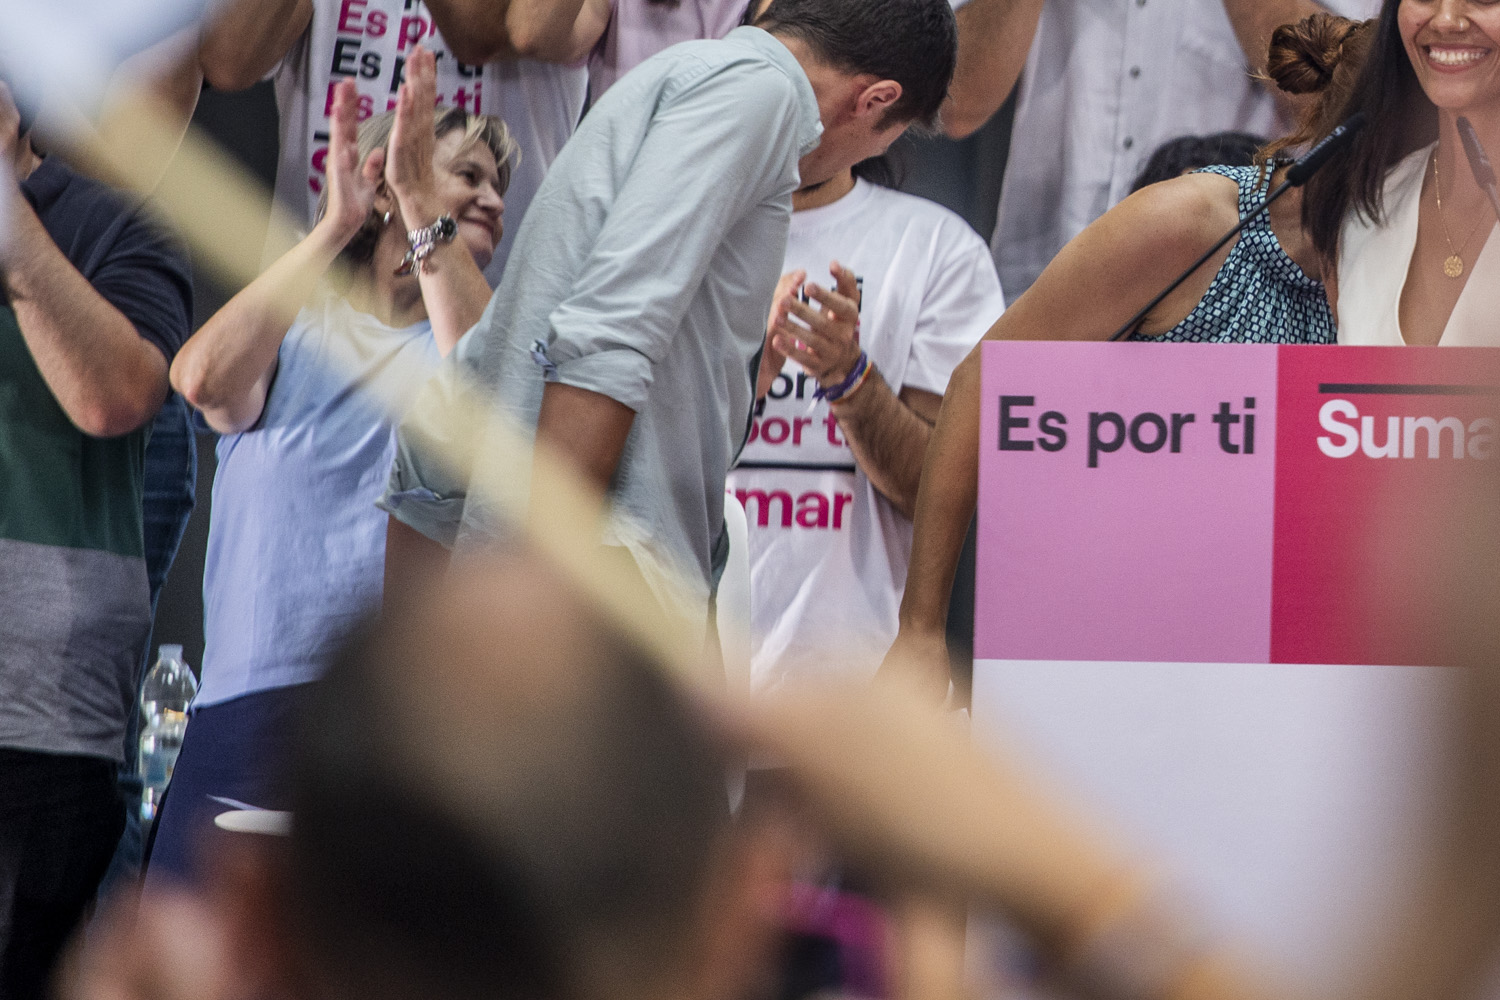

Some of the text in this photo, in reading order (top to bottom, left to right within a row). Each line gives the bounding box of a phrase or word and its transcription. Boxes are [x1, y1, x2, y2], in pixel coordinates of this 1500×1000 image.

[330, 37, 382, 80] Es
[997, 394, 1257, 469] Es por ti
[727, 489, 853, 530] mar
